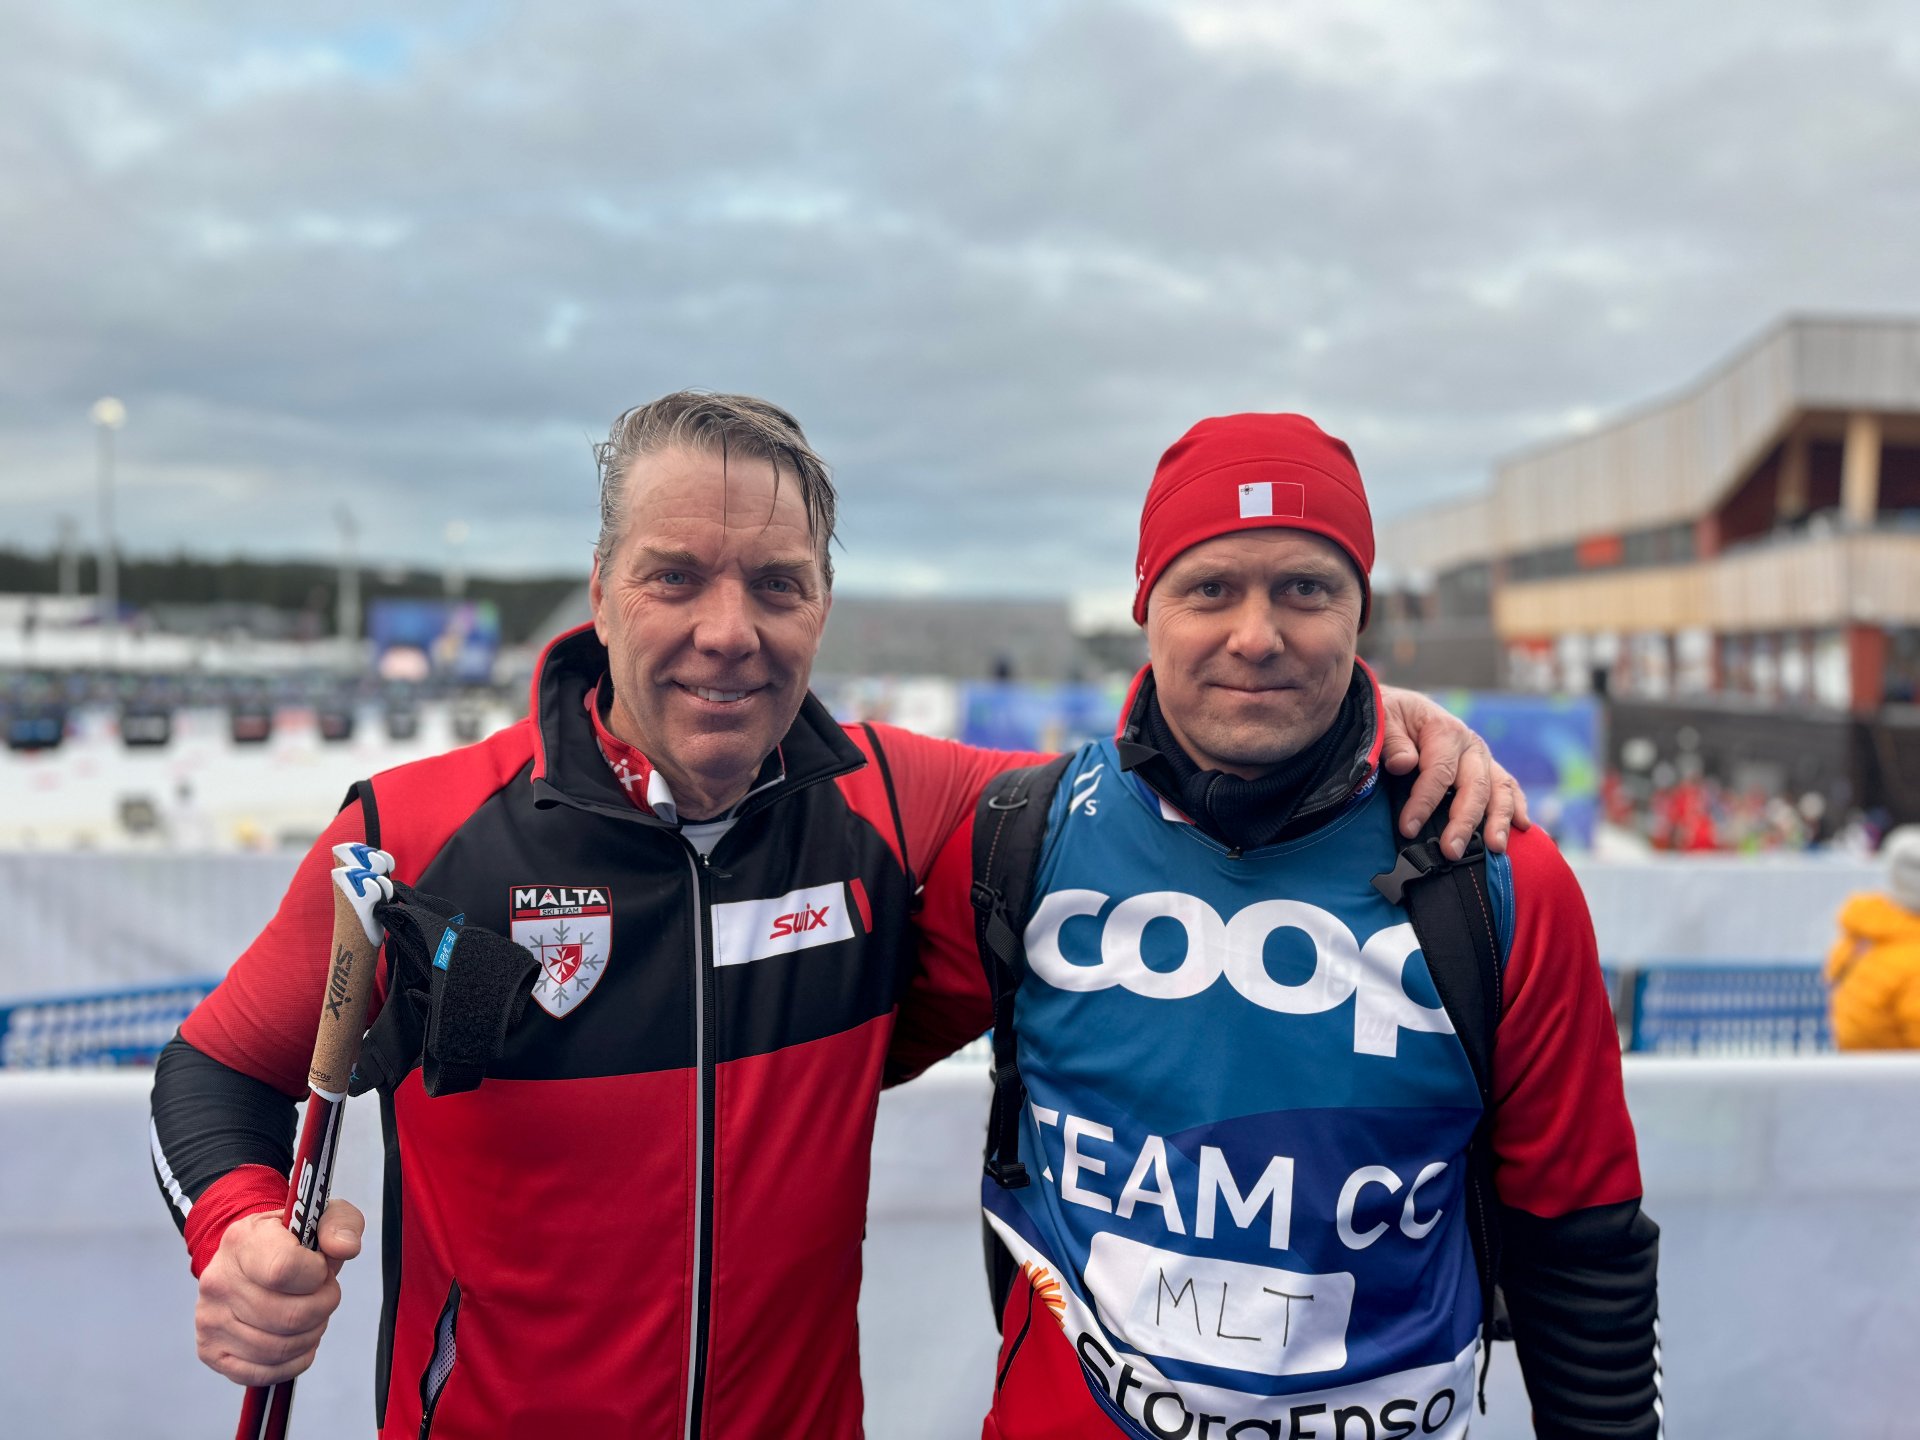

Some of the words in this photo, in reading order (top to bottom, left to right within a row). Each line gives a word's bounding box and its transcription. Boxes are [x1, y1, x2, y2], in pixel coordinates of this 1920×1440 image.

[515, 888, 607, 909] MALTA
[542, 908, 555, 916] SKI
[558, 907, 579, 915] TEAM
[1023, 888, 1457, 1058] coop
[1155, 1266, 1315, 1347] MLT
